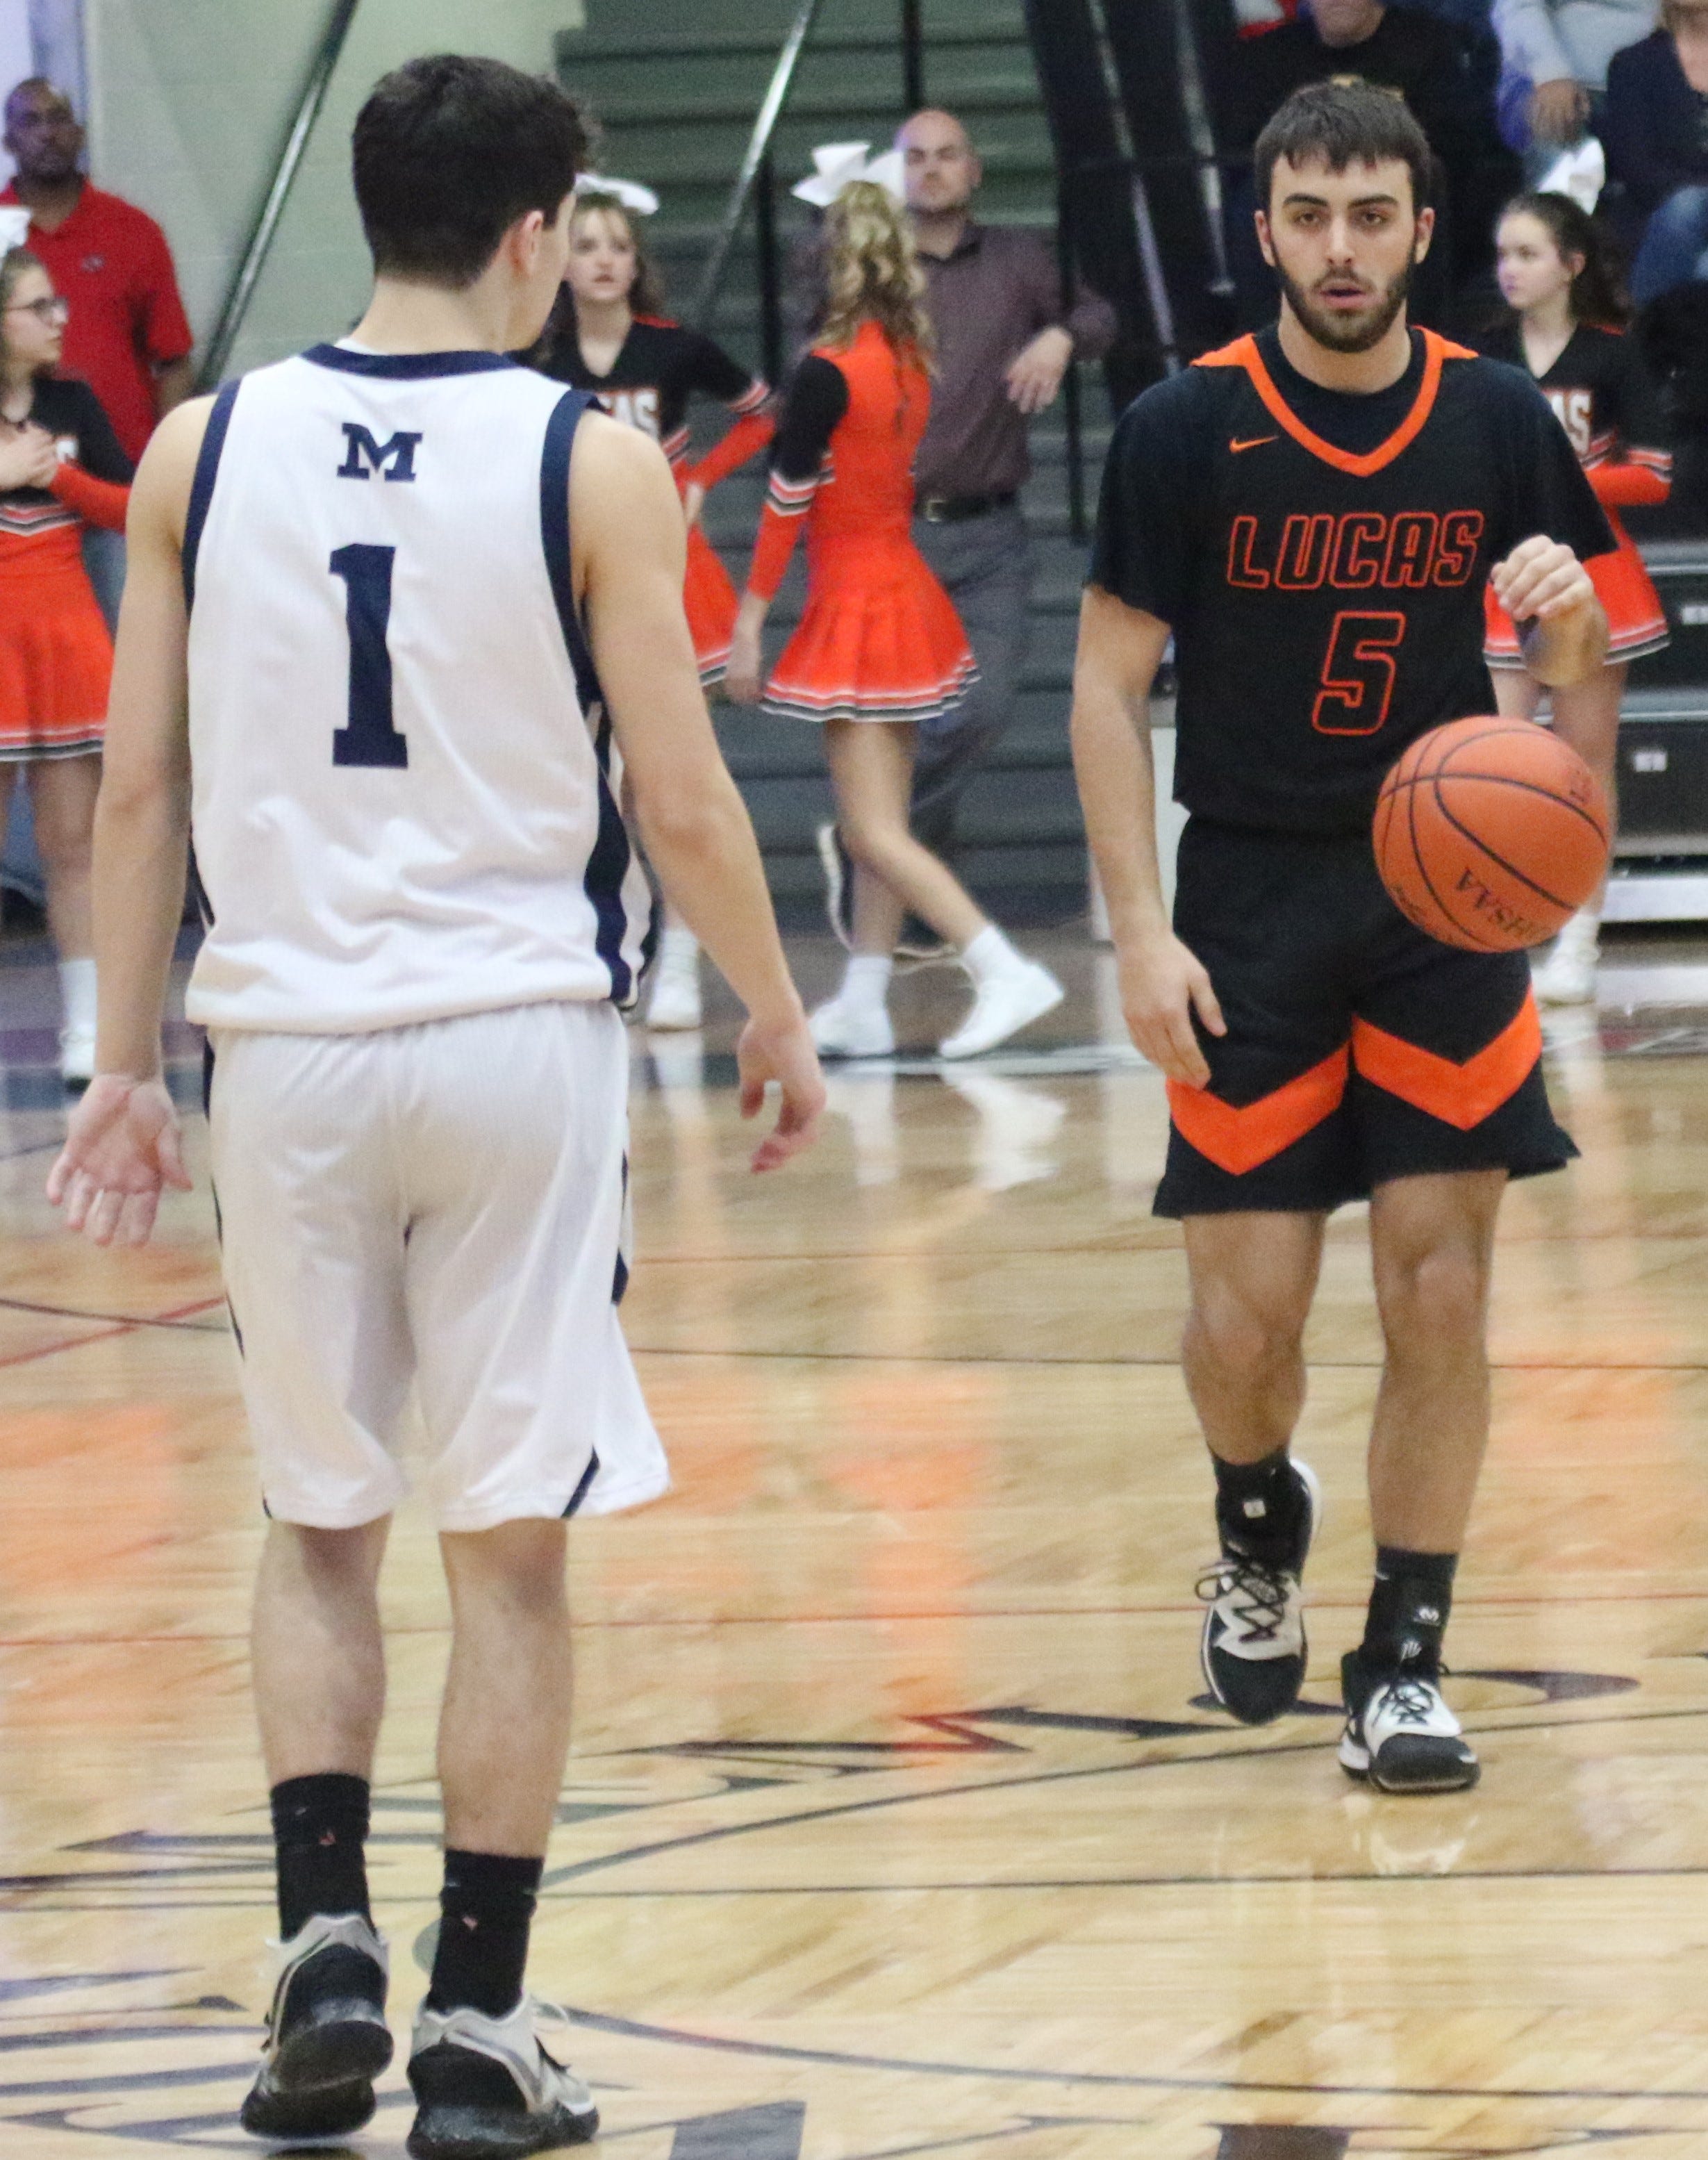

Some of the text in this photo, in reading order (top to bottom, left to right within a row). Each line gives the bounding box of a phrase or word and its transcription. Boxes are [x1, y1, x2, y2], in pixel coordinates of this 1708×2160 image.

[336, 422, 424, 482] M
[1227, 510, 1484, 590] LUCAS
[329, 543, 408, 769] 1
[1311, 611, 1407, 736] 5
